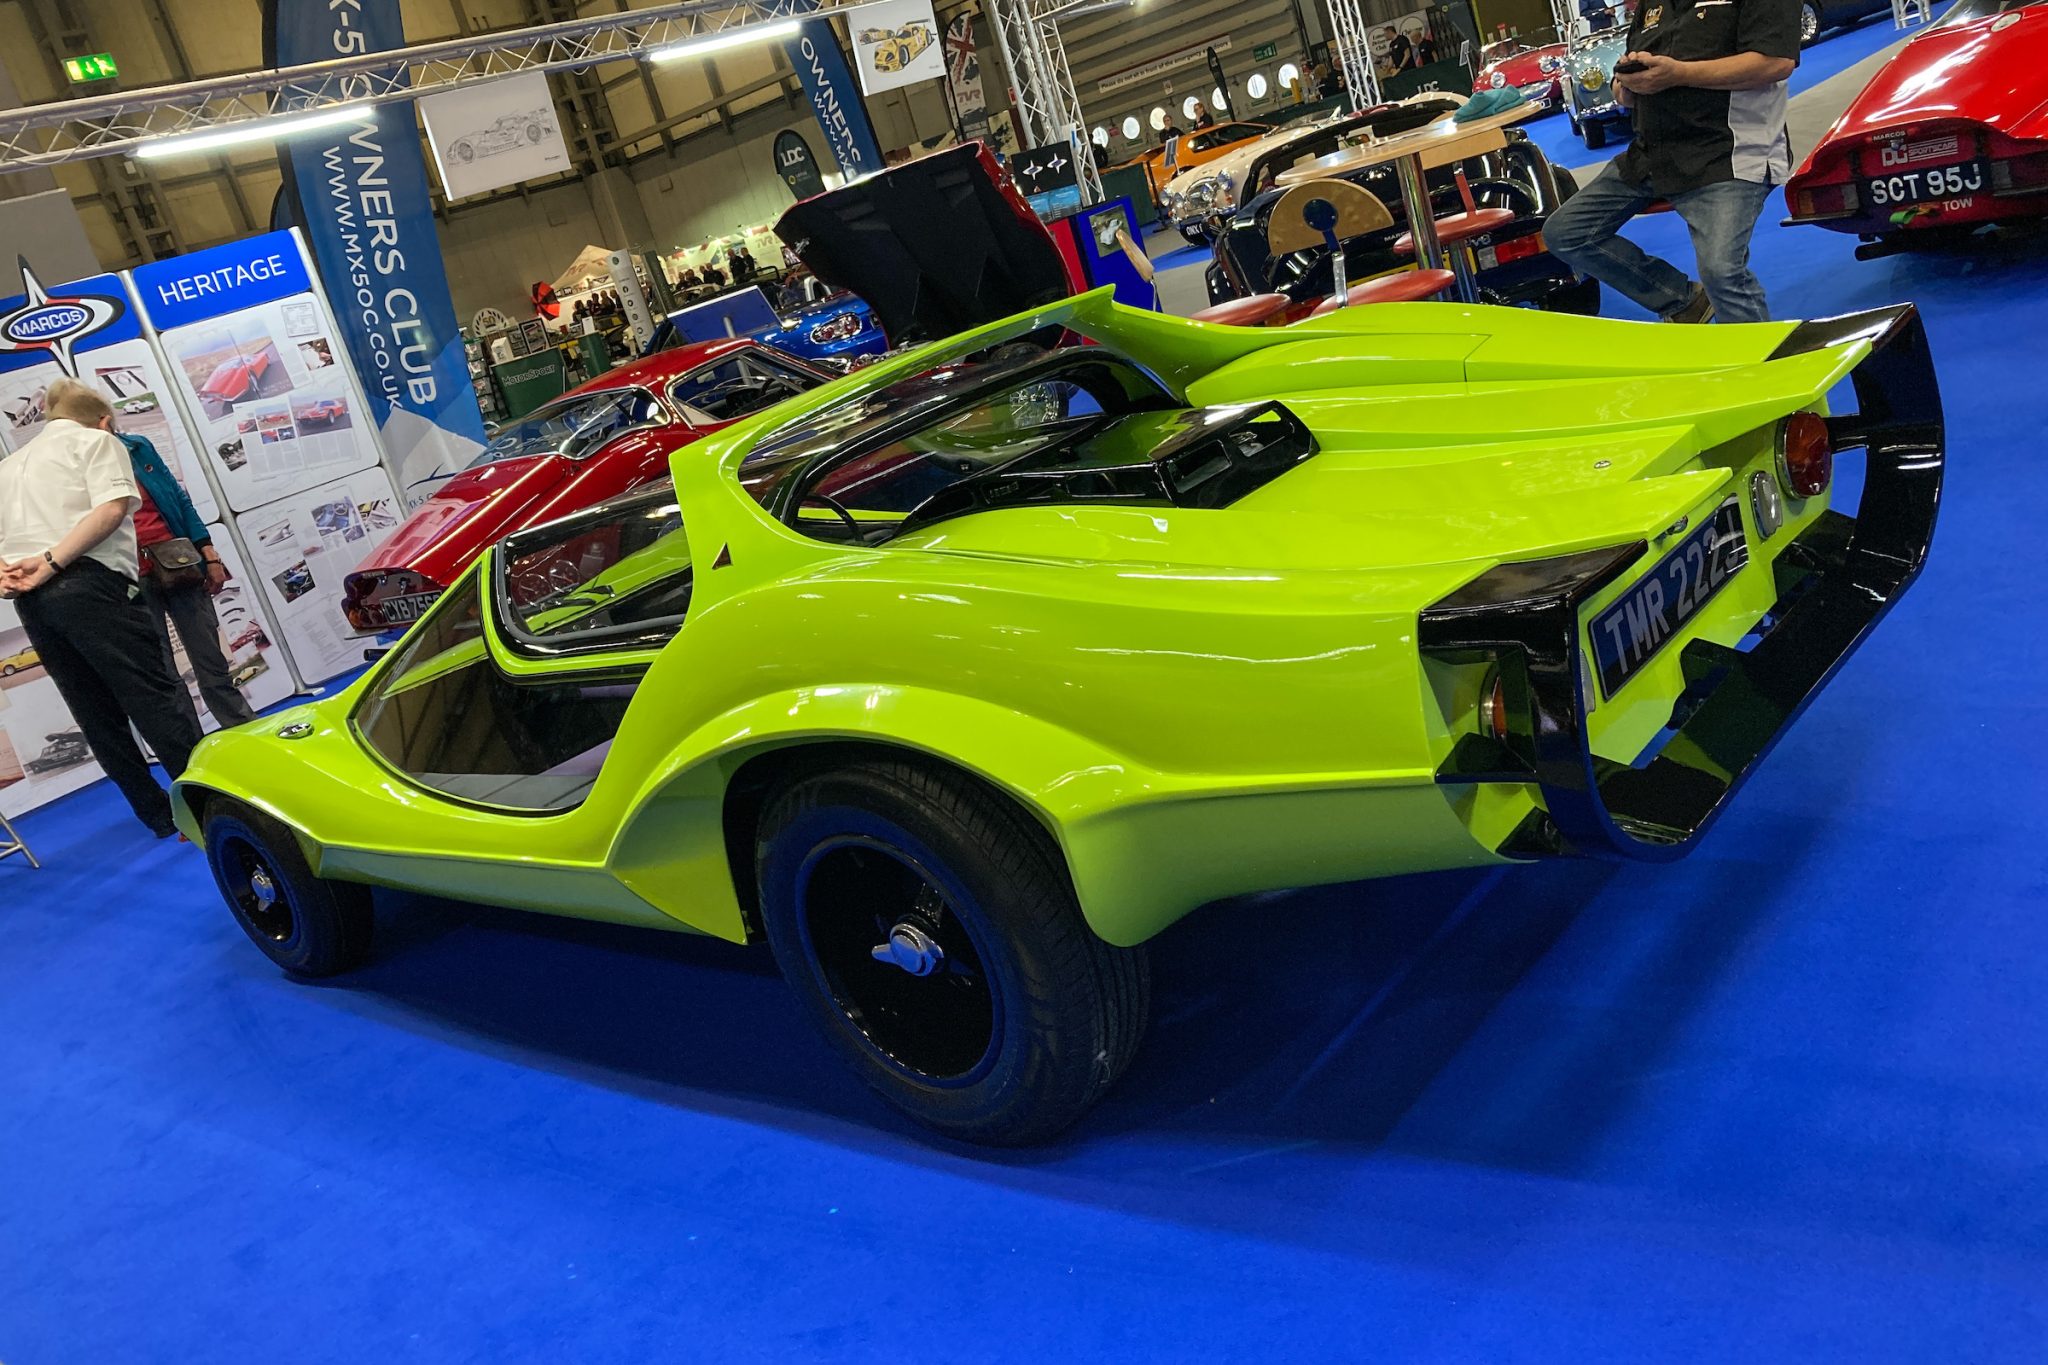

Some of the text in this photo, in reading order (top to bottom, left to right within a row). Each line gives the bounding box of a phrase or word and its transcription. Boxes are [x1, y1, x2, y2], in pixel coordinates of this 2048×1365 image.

[956, 89, 981, 103] TVR
[1873, 130, 1906, 141] MARCOS
[781, 146, 805, 167] LDC
[1871, 163, 1982, 204] SCT 95J
[1943, 197, 1973, 212] TOW
[1384, 230, 1410, 241] MARC
[158, 254, 287, 306] HERITAGE
[14, 310, 82, 336] MARCOS
[384, 288, 437, 405] CLUB
[1604, 510, 1739, 675] TMR 222J
[384, 594, 440, 621] CYB 756
